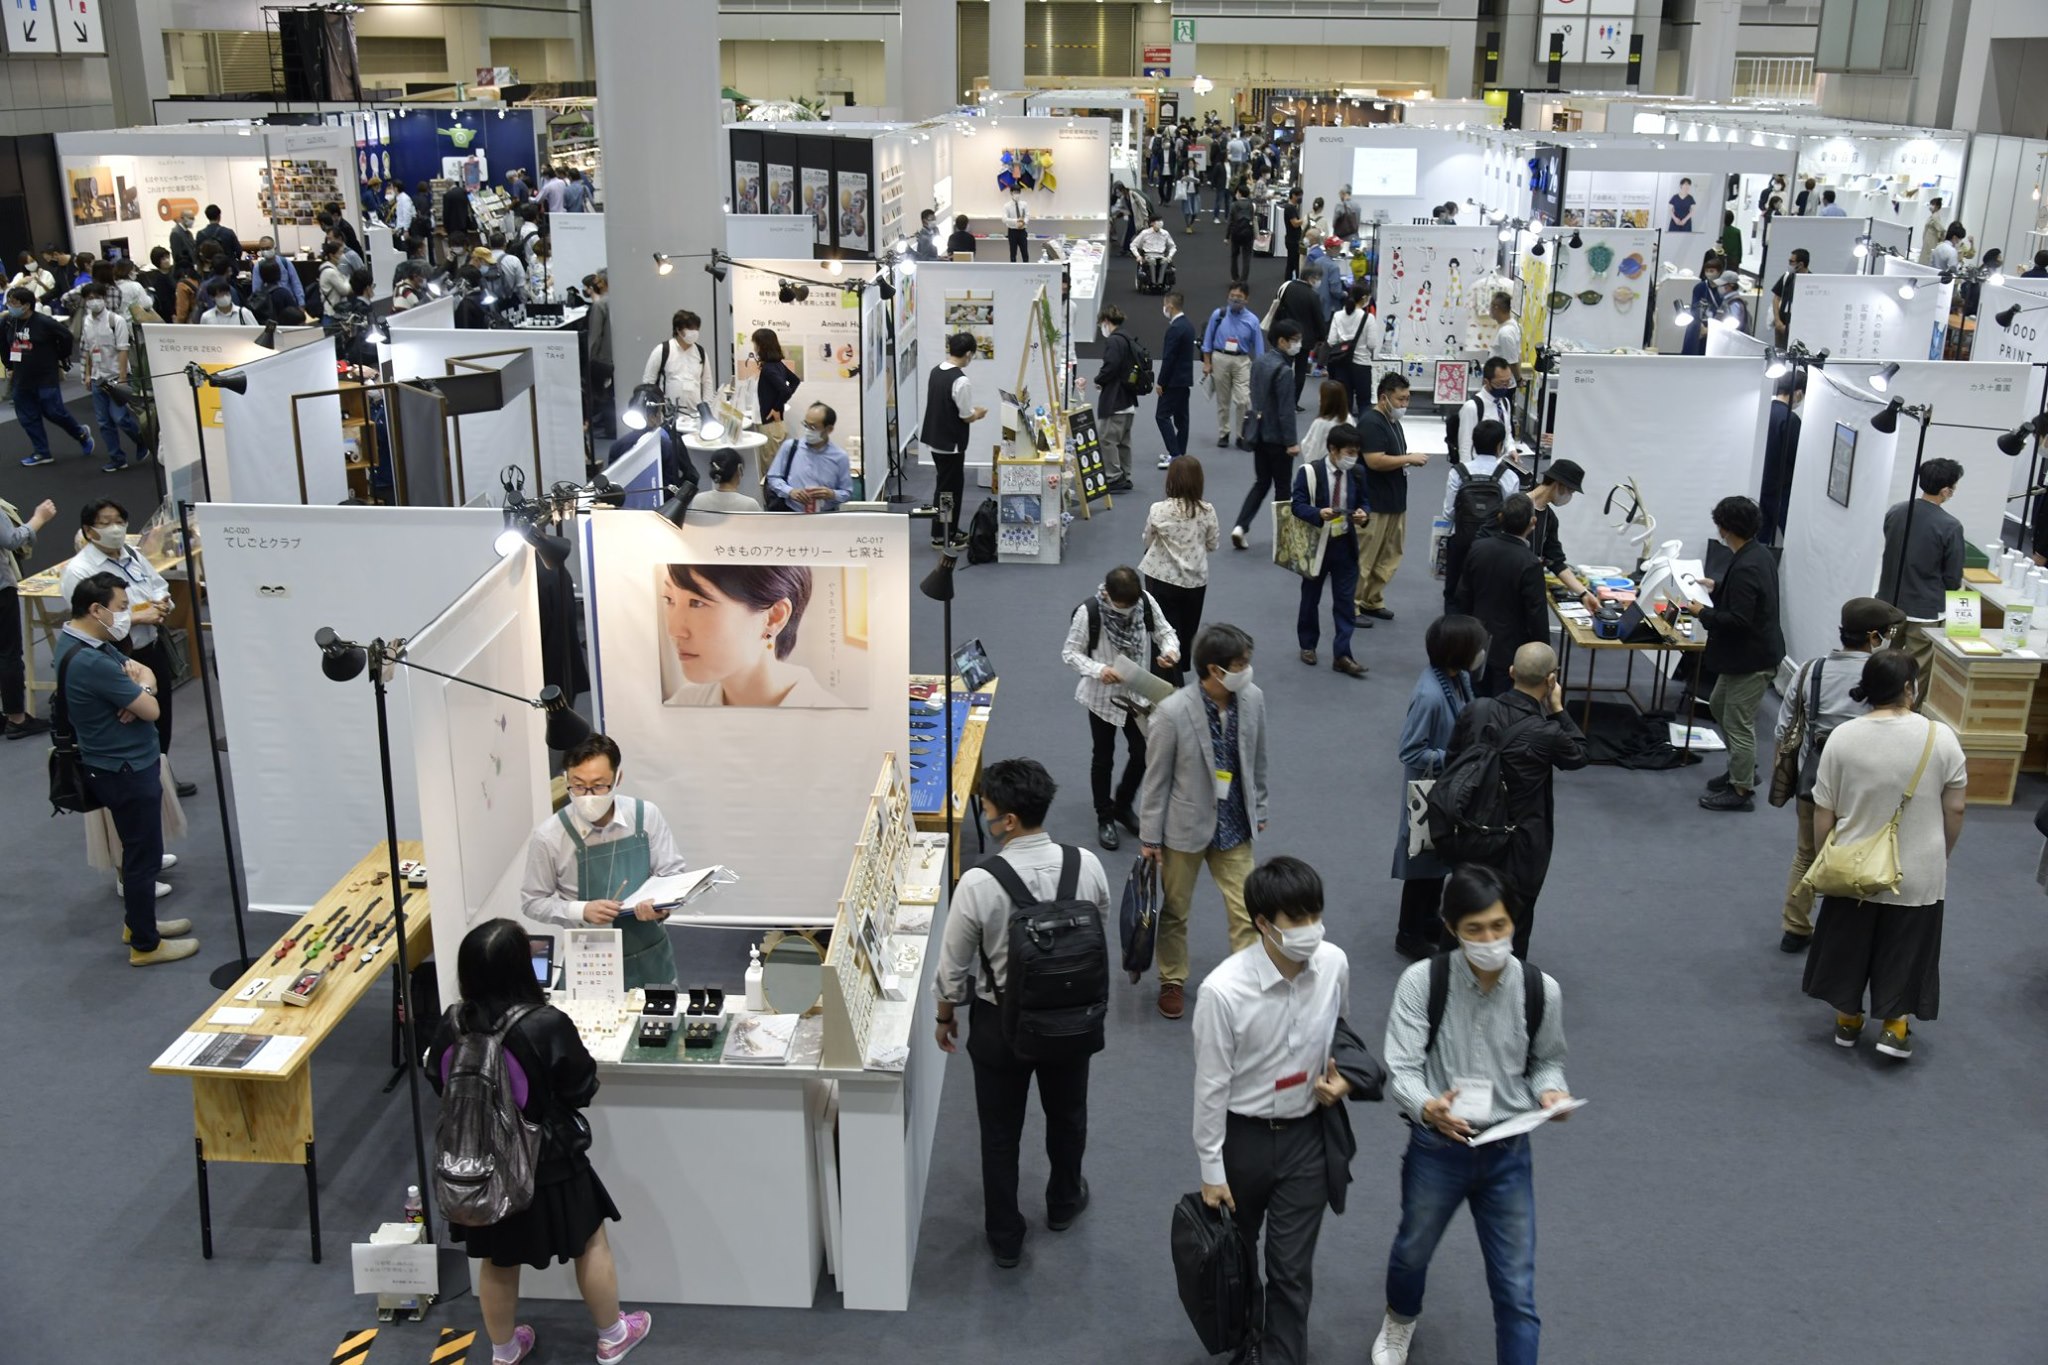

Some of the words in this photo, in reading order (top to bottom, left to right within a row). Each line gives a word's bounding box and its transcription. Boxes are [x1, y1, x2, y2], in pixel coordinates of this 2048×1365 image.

[752, 320, 765, 328] Clip
[768, 320, 791, 328] Family
[821, 320, 848, 328] Animal
[856, 536, 884, 544] AC-017
[714, 545, 833, 558] やきものアクセサリー
